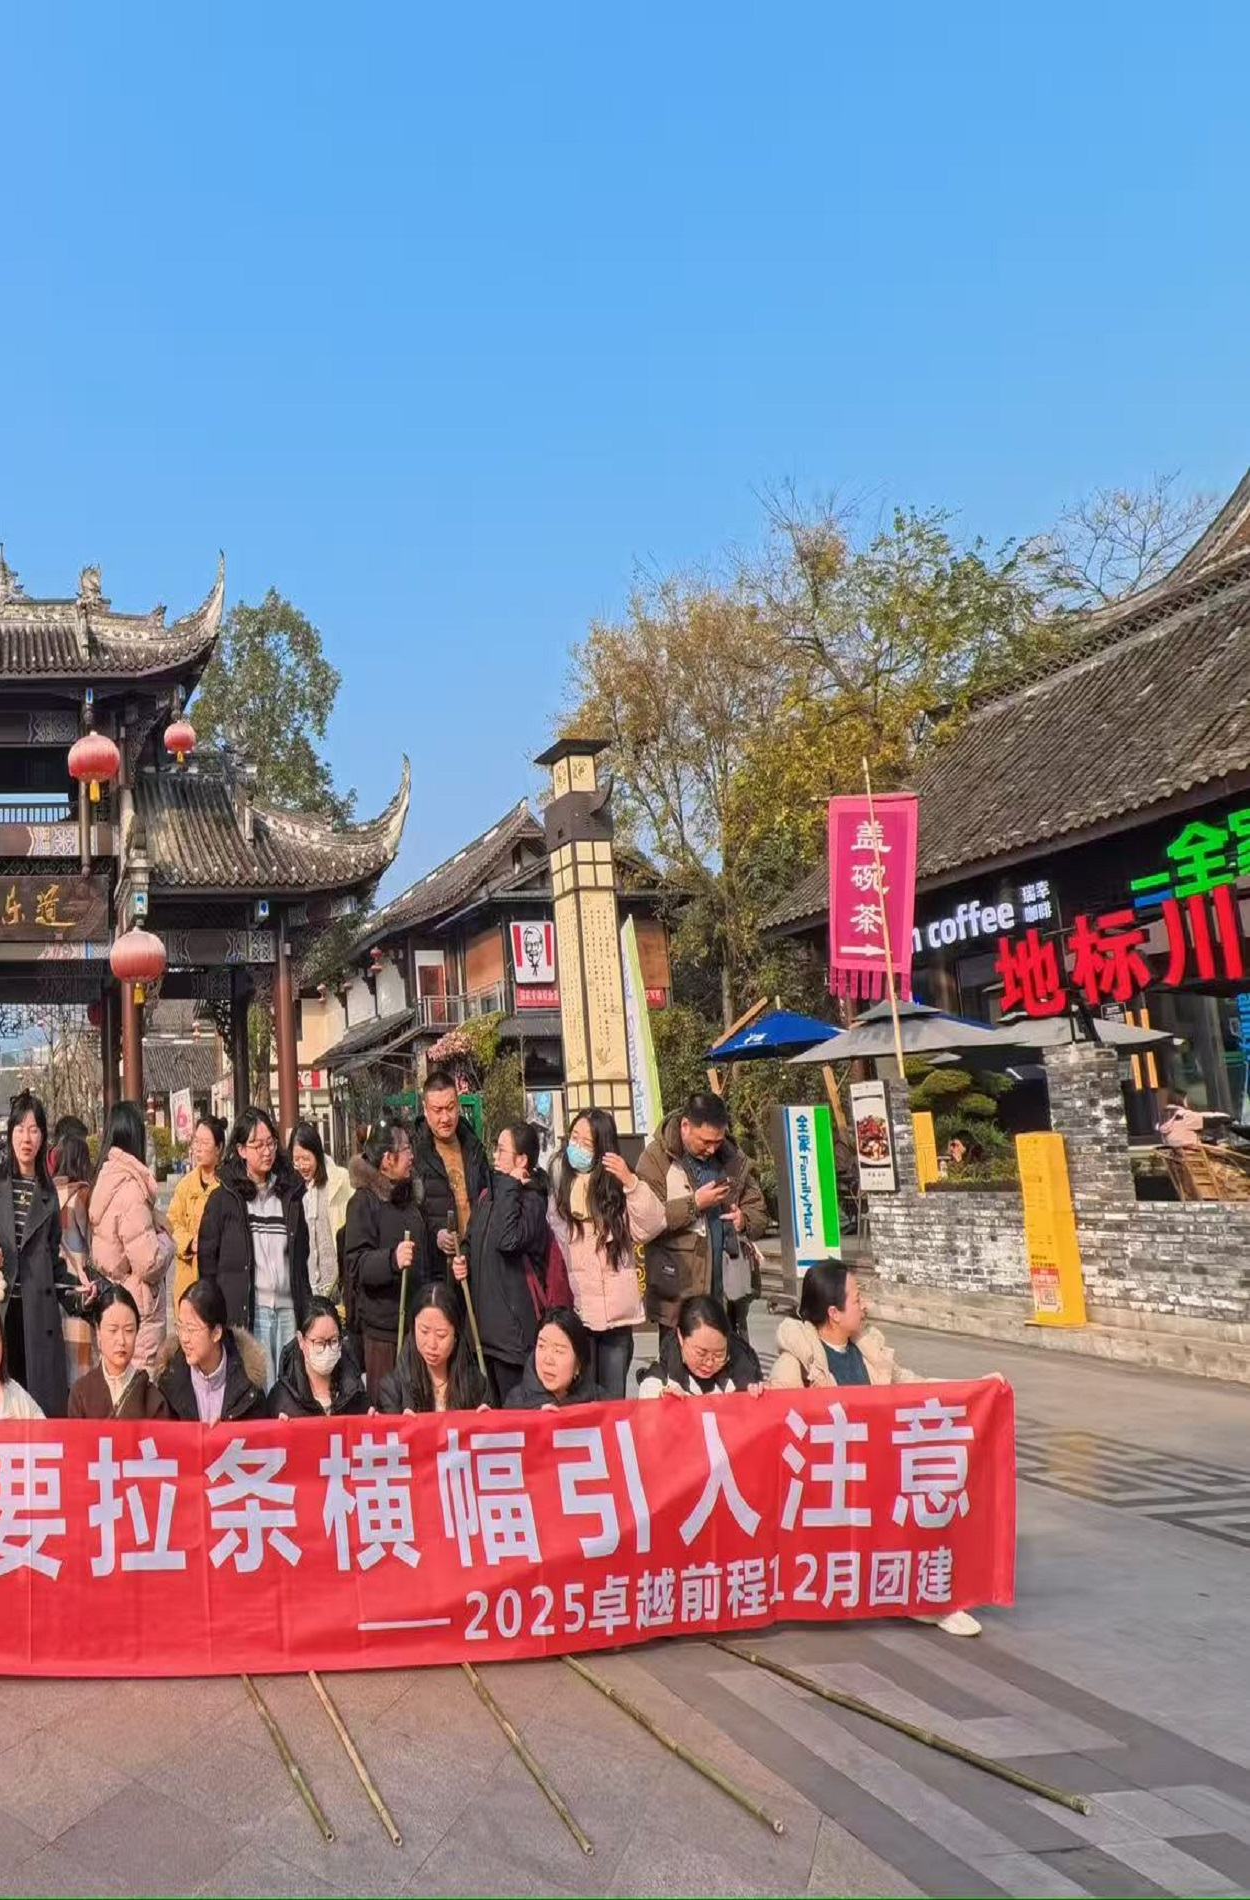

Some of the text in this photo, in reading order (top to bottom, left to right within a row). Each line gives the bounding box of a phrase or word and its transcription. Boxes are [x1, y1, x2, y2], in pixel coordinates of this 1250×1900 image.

[850, 820, 892, 935] 盖碗茶
[1021, 879, 1050, 903] 瑞幸
[927, 900, 1016, 949] coffee
[1023, 901, 1053, 923] 咖啡
[995, 884, 1244, 1018] 地标川
[799, 1155, 815, 1239] FamilyMart
